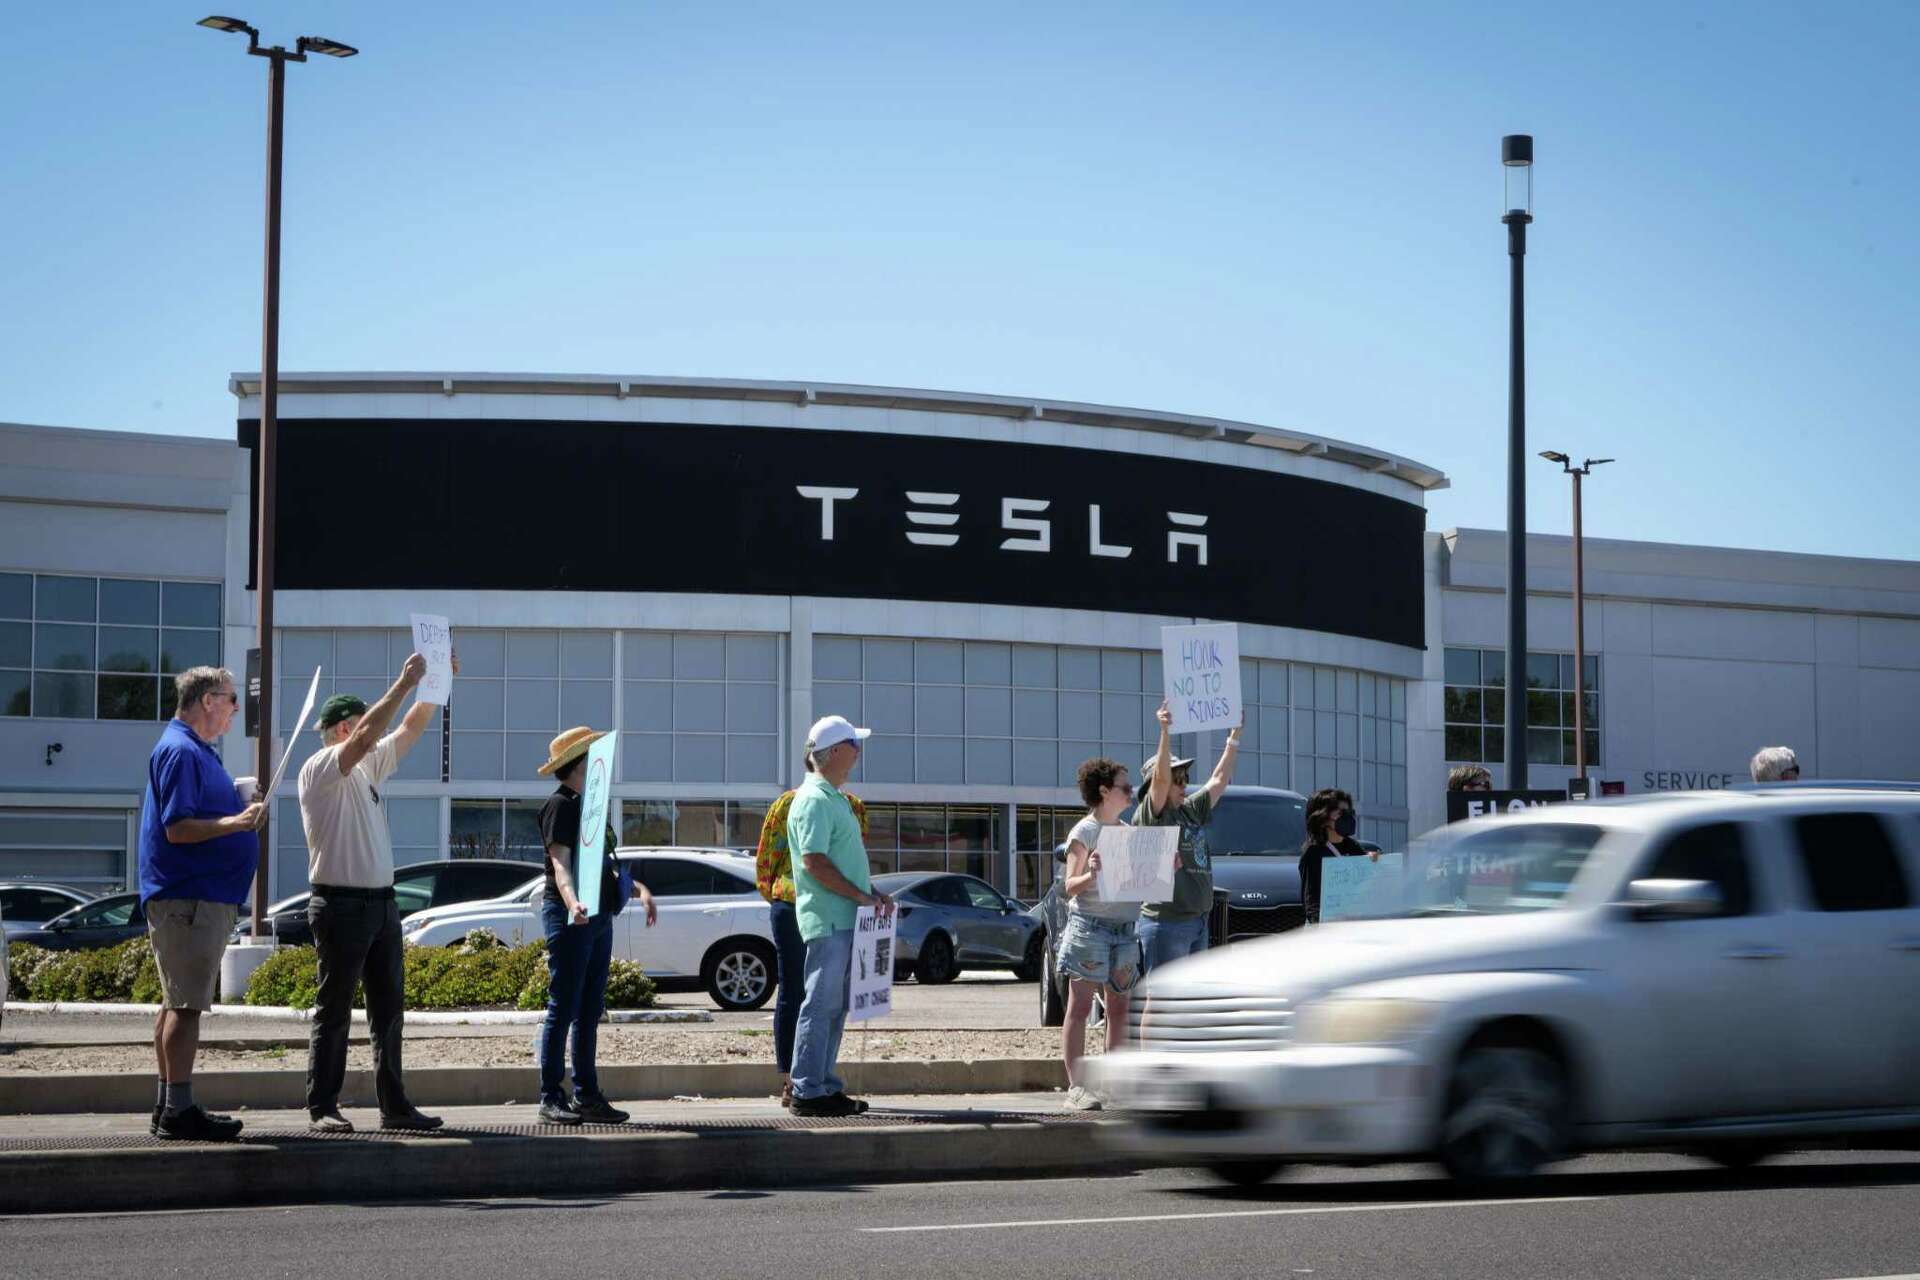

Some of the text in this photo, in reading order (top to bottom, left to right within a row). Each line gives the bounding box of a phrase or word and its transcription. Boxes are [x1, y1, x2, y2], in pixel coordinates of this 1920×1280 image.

[796, 485, 1208, 566] TESLA
[1182, 640, 1223, 671] HONK
[1174, 672, 1221, 697] NO TO
[1188, 697, 1230, 723] KINGS
[1643, 771, 1733, 791] SERVICE
[859, 916, 876, 932] NASTY
